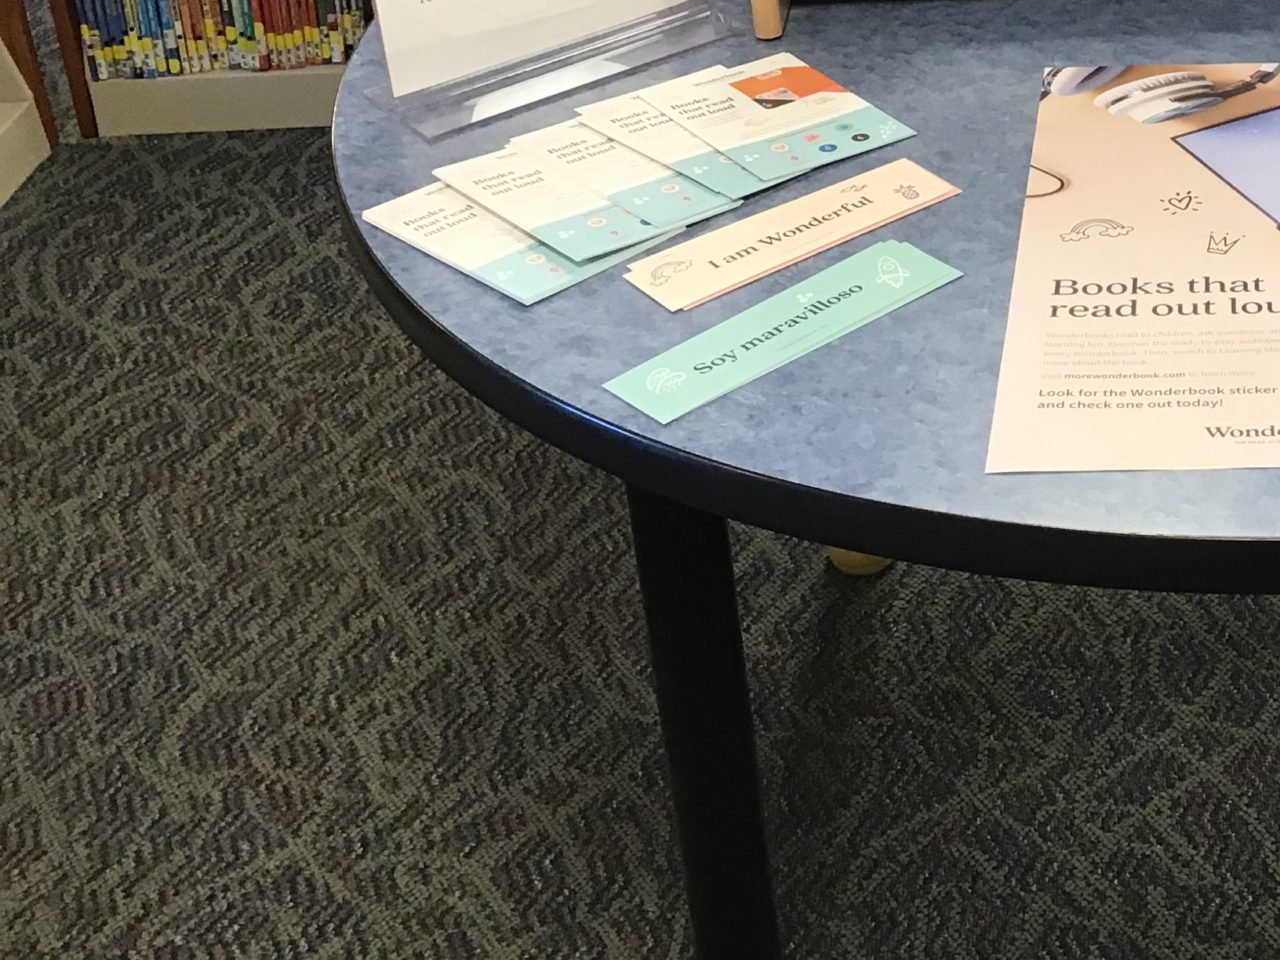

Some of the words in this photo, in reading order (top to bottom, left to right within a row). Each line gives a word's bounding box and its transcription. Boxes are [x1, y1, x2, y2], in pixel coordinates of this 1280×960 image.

[402, 208, 447, 226] Books
[413, 219, 440, 232] that
[443, 204, 474, 221] read
[448, 212, 477, 228] loud
[707, 259, 720, 269] I
[723, 246, 759, 264] am
[757, 196, 874, 246] Wonderful
[1051, 277, 1175, 296] Books
[1188, 276, 1266, 294] that
[1048, 299, 1138, 318] read
[1151, 299, 1217, 316] out
[693, 349, 738, 374] Soy
[740, 284, 864, 352] maravilloso
[1064, 372, 1186, 380] morewonderbook.com
[1038, 389, 1075, 397] Look
[1078, 388, 1100, 397] for
[1103, 388, 1127, 397] the
[1130, 387, 1225, 396] Wonderbook
[1229, 386, 1278, 394] sticker
[1037, 400, 1065, 409] and
[1068, 400, 1113, 408] check
[1147, 400, 1173, 408] out
[1176, 398, 1223, 410] today!
